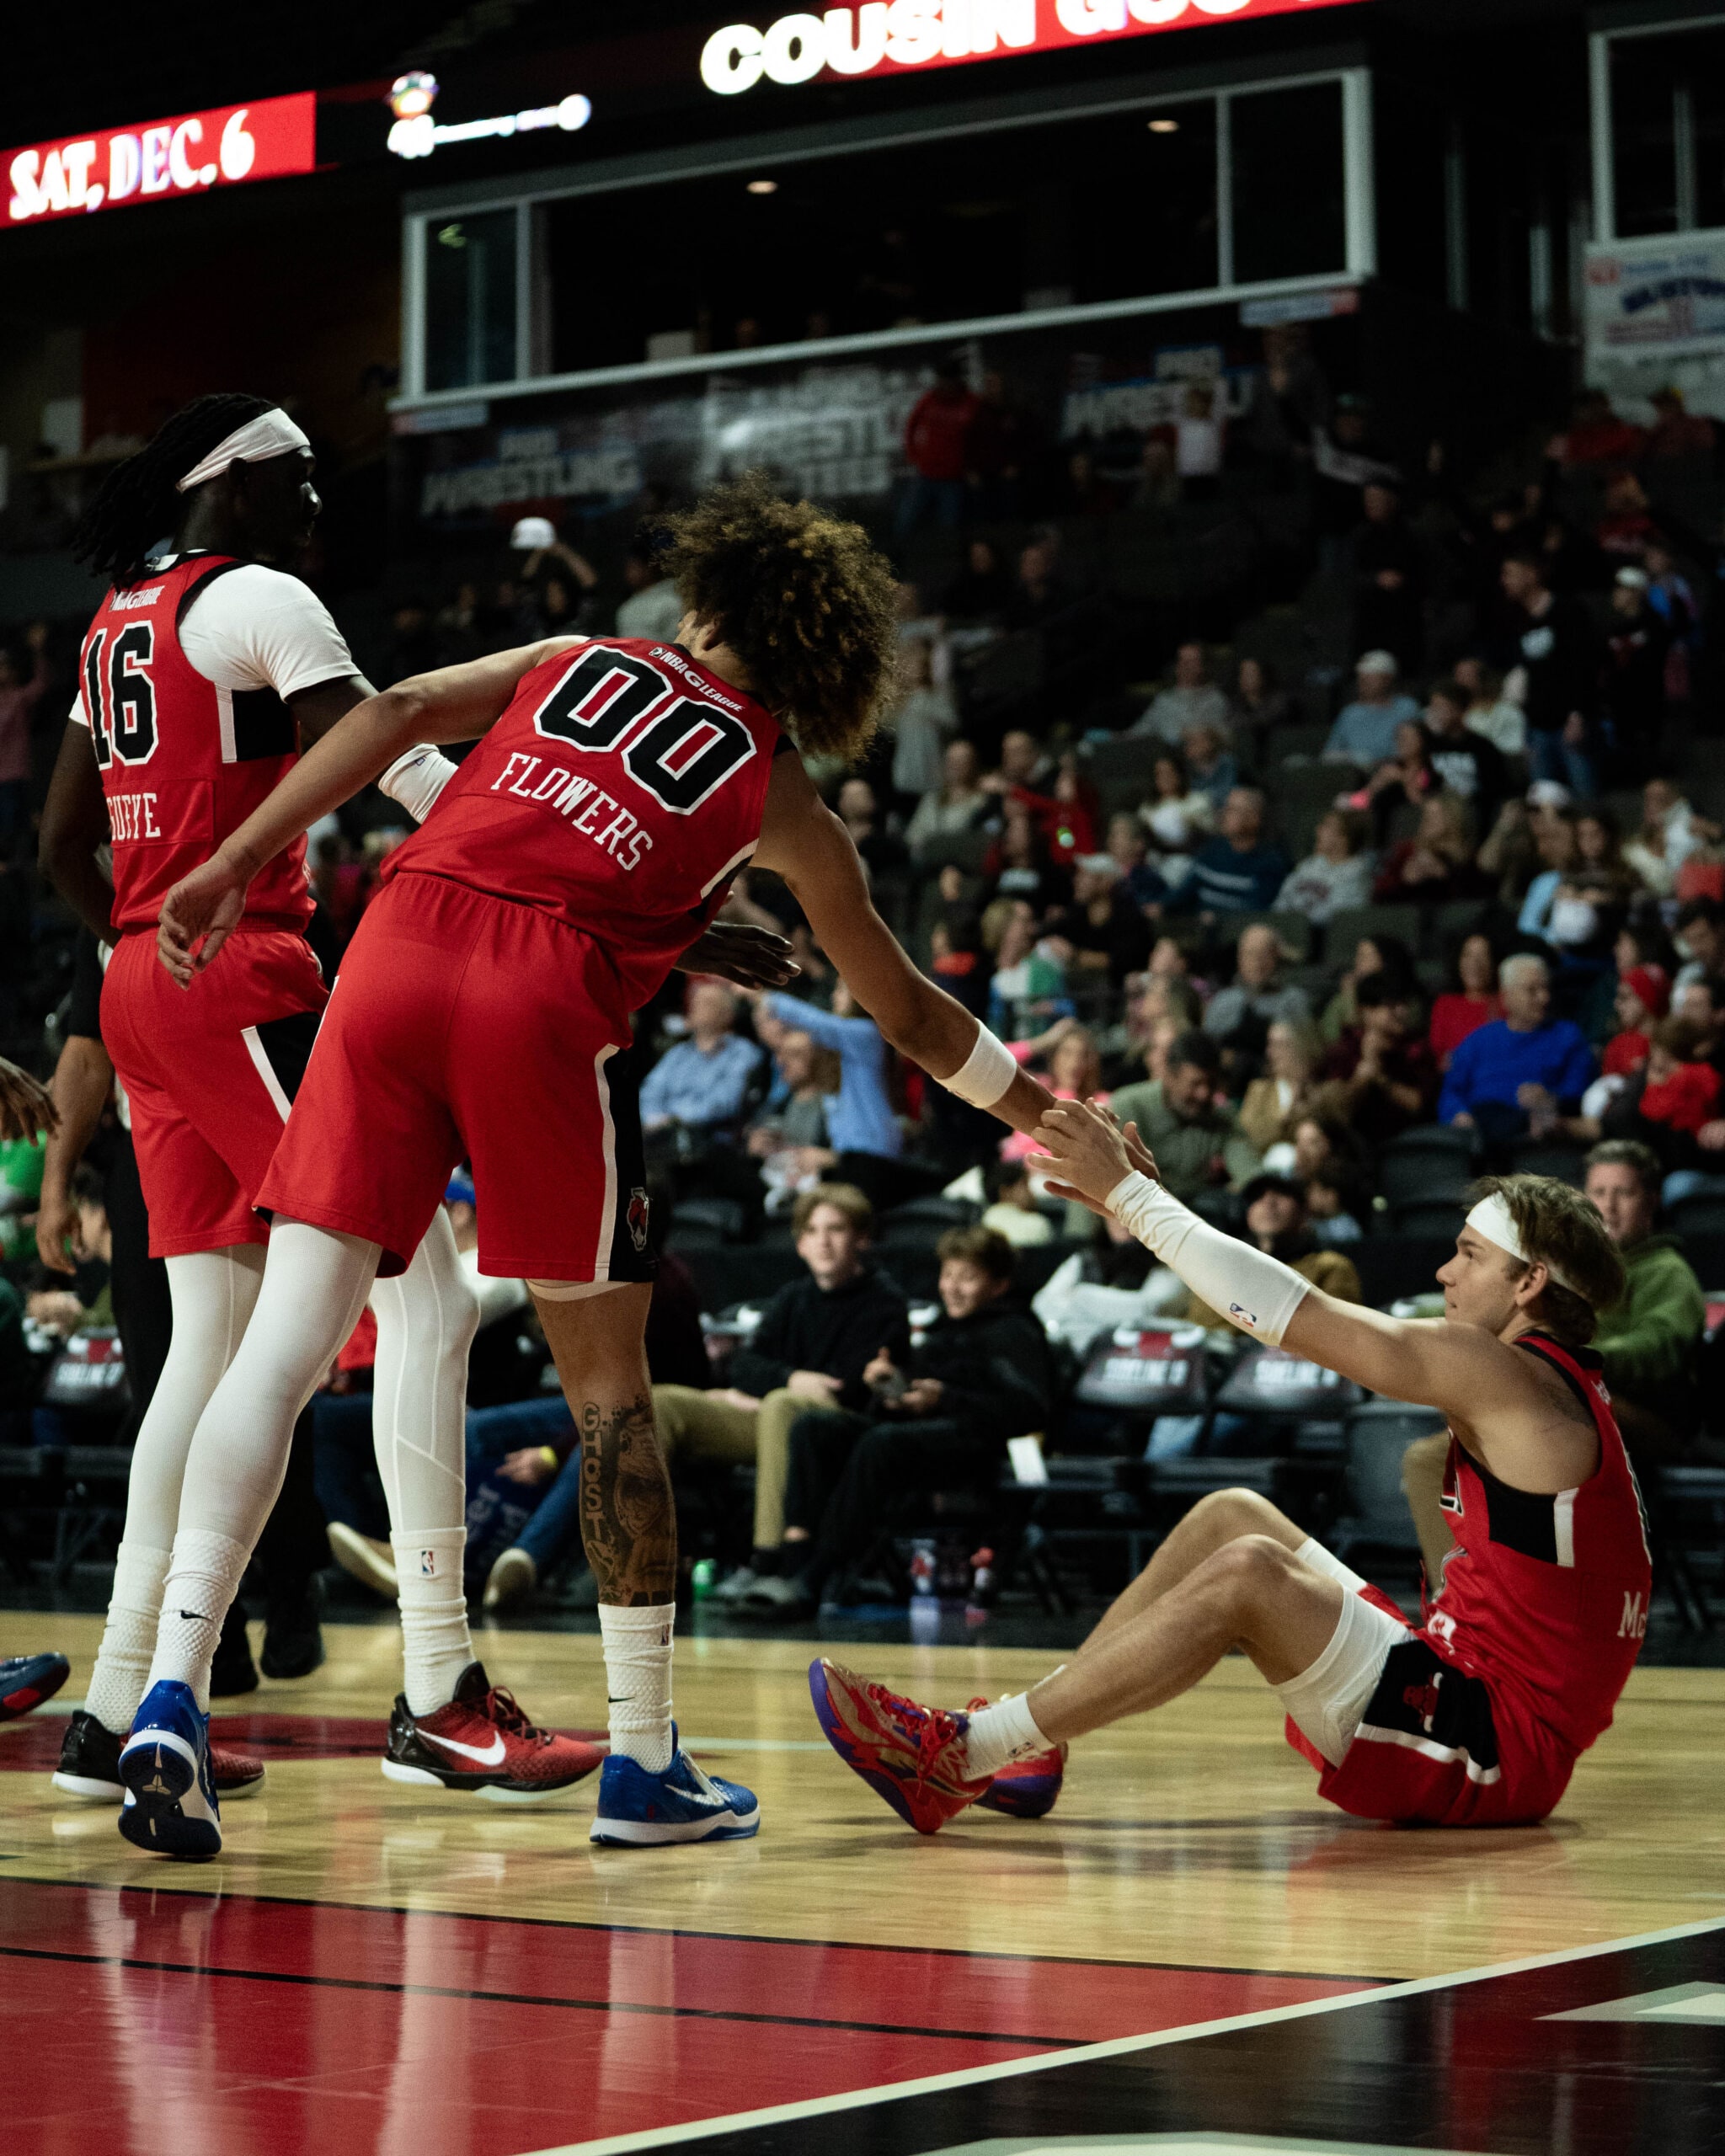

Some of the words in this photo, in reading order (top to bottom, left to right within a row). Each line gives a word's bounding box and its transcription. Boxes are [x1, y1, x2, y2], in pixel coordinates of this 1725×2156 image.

[700, 0, 1036, 95] COUSIN
[10, 140, 104, 220] SAT,
[108, 119, 217, 200] DEC.
[220, 109, 255, 180] 6
[83, 620, 159, 771] 16
[533, 644, 757, 816] 00
[660, 651, 689, 675] NBA
[684, 670, 705, 687] G
[698, 684, 745, 712] LEAGUE
[490, 752, 654, 871] FLOWERS
